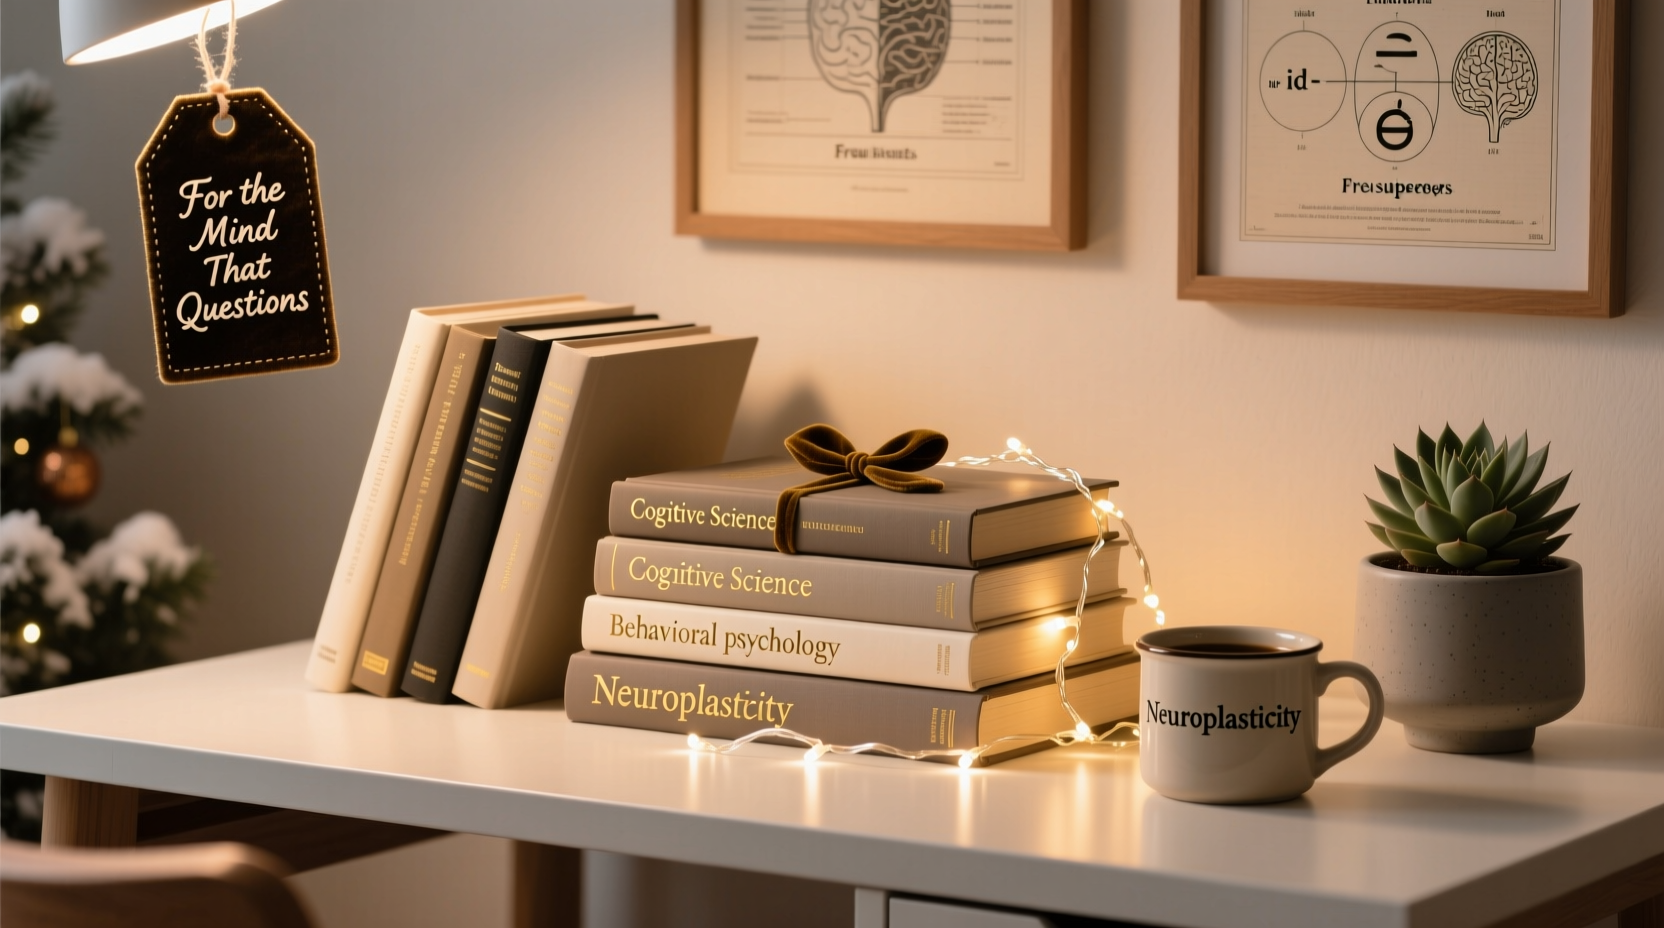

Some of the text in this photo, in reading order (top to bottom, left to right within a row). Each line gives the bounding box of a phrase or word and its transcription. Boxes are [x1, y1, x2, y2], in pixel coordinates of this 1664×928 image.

[179, 171, 286, 219] For the
[189, 208, 279, 252] Mind
[203, 252, 272, 287] That
[176, 288, 309, 332] Questions
[630, 497, 705, 529] Cogitive
[709, 505, 776, 531] Science
[730, 566, 812, 597] Science
[609, 613, 841, 666] Behavioral psychology
[1146, 699, 1302, 736] Neuroplasticity
